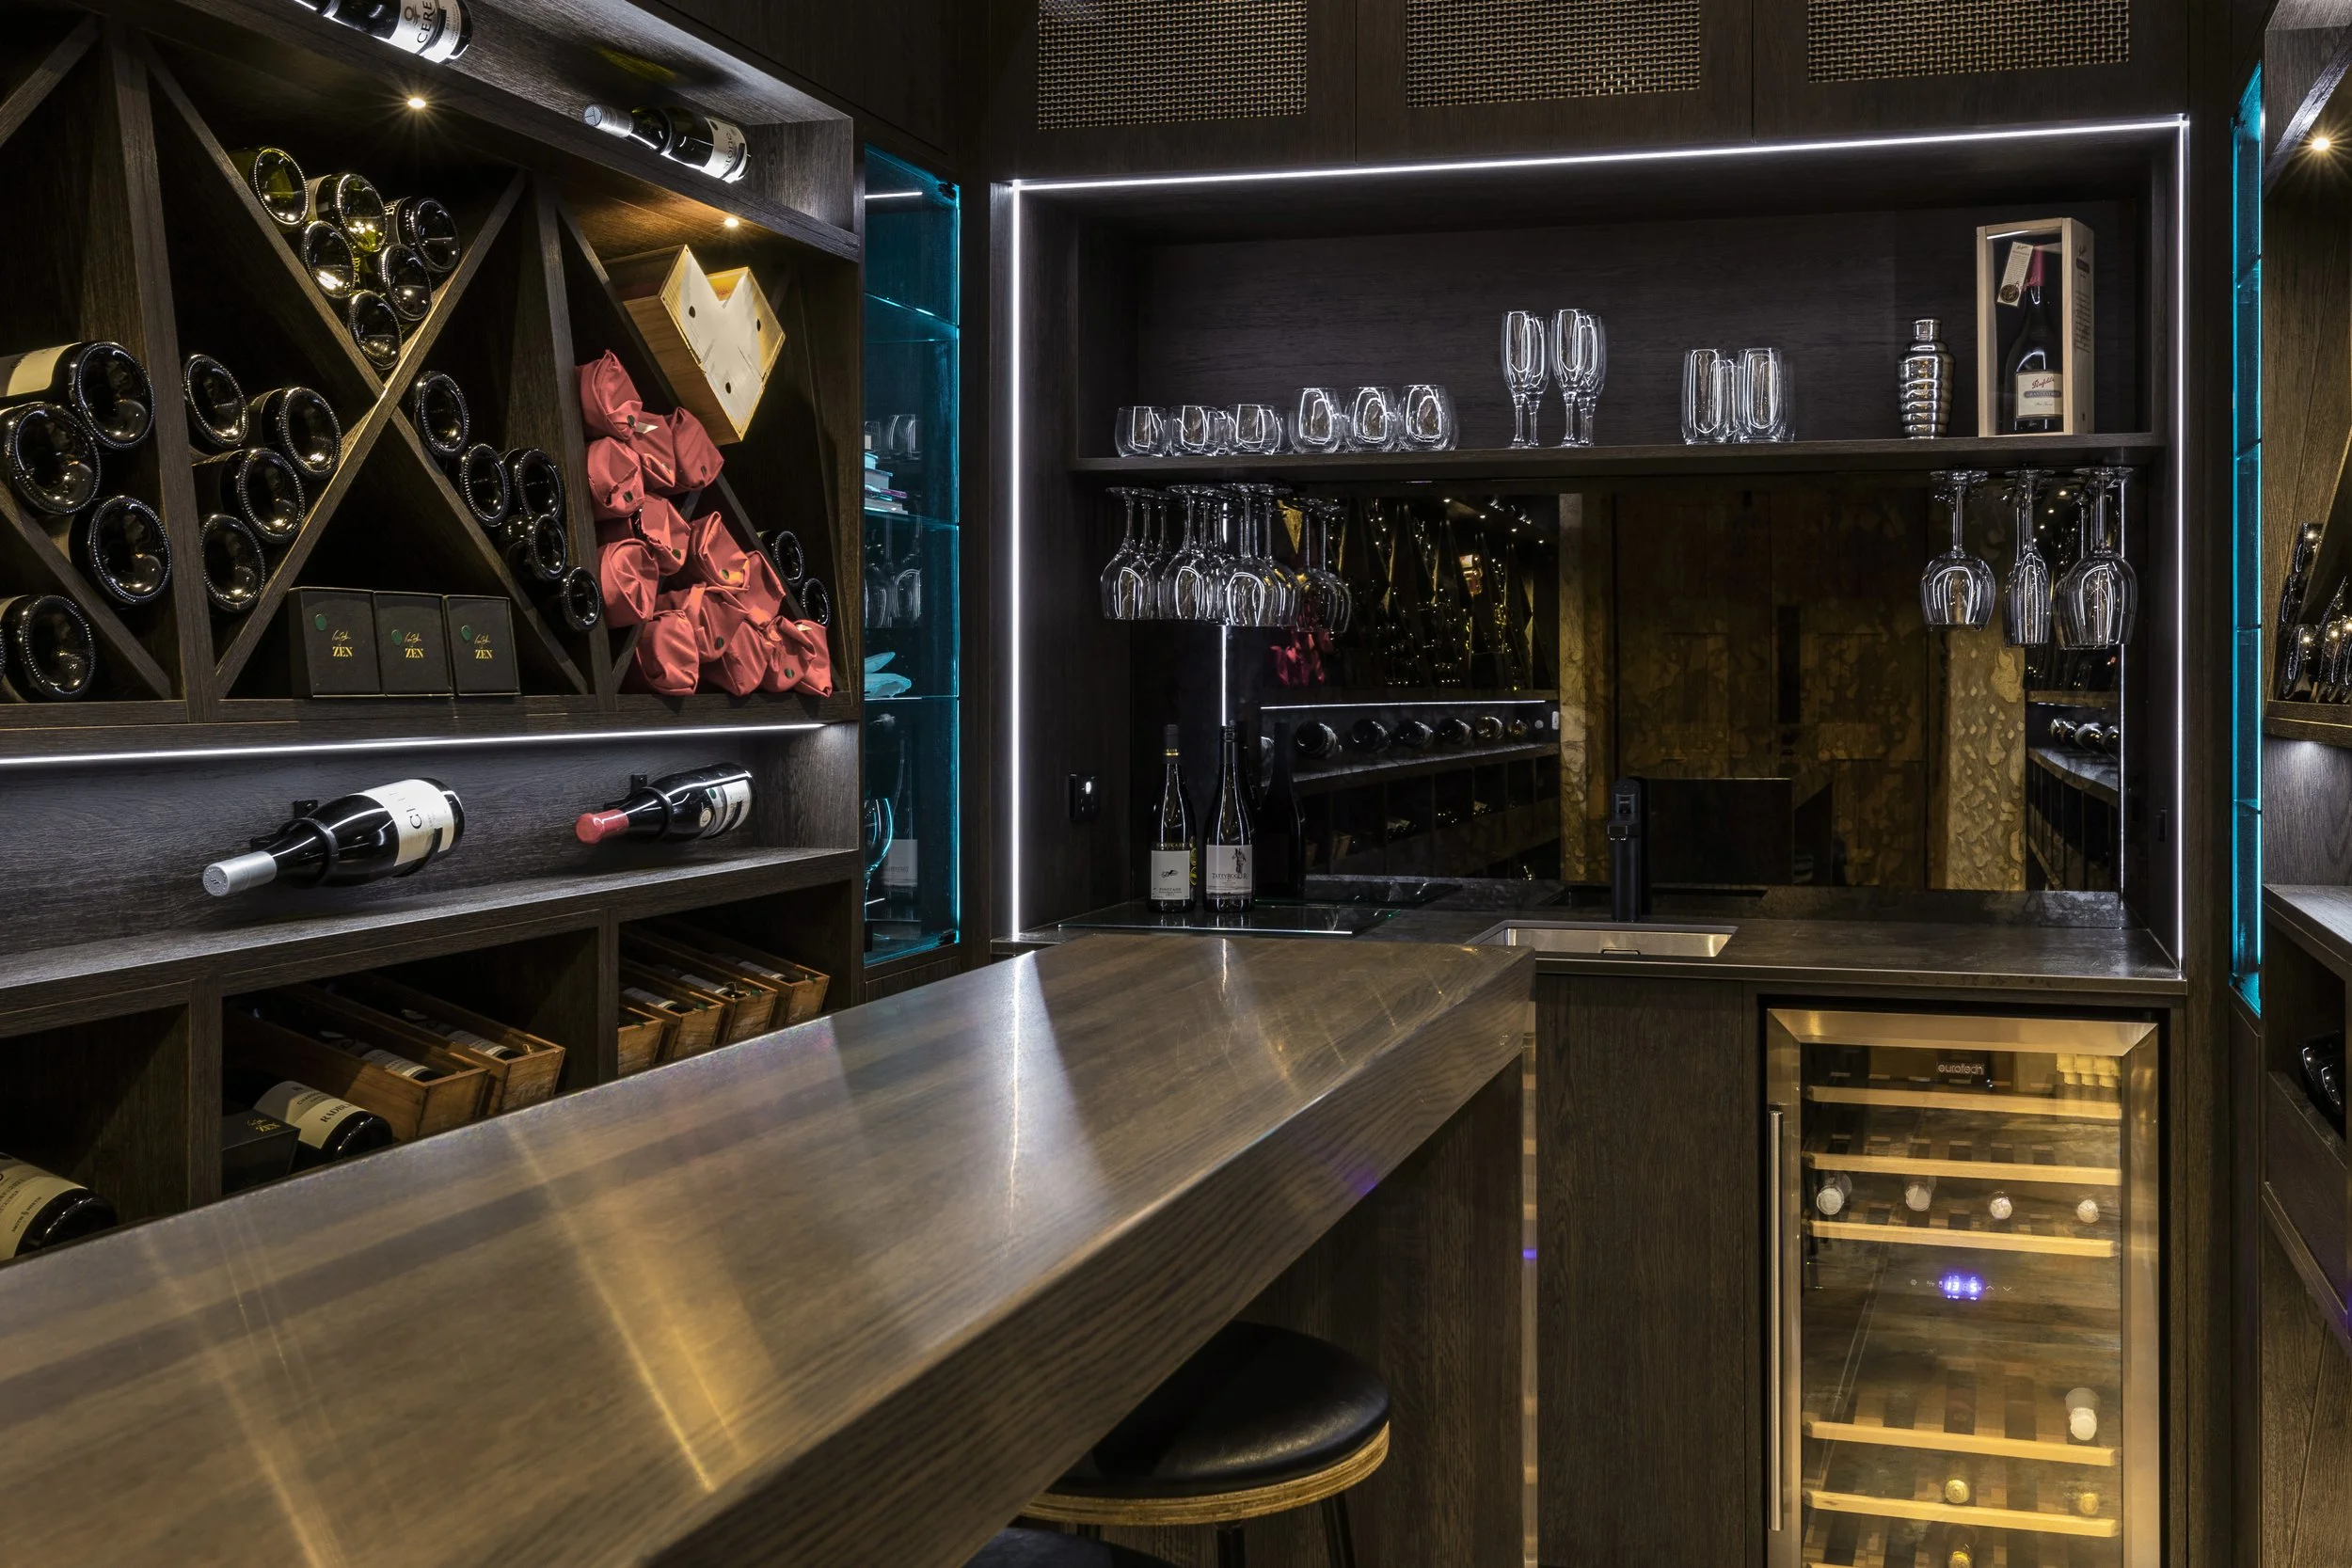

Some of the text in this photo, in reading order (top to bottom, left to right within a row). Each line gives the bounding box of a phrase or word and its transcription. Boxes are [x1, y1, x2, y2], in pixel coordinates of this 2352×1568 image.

[332, 646, 353, 657] ZEN
[405, 647, 423, 658] ZEN
[475, 649, 493, 659] ZEN
[1938, 1063, 1984, 1076] eurotech
